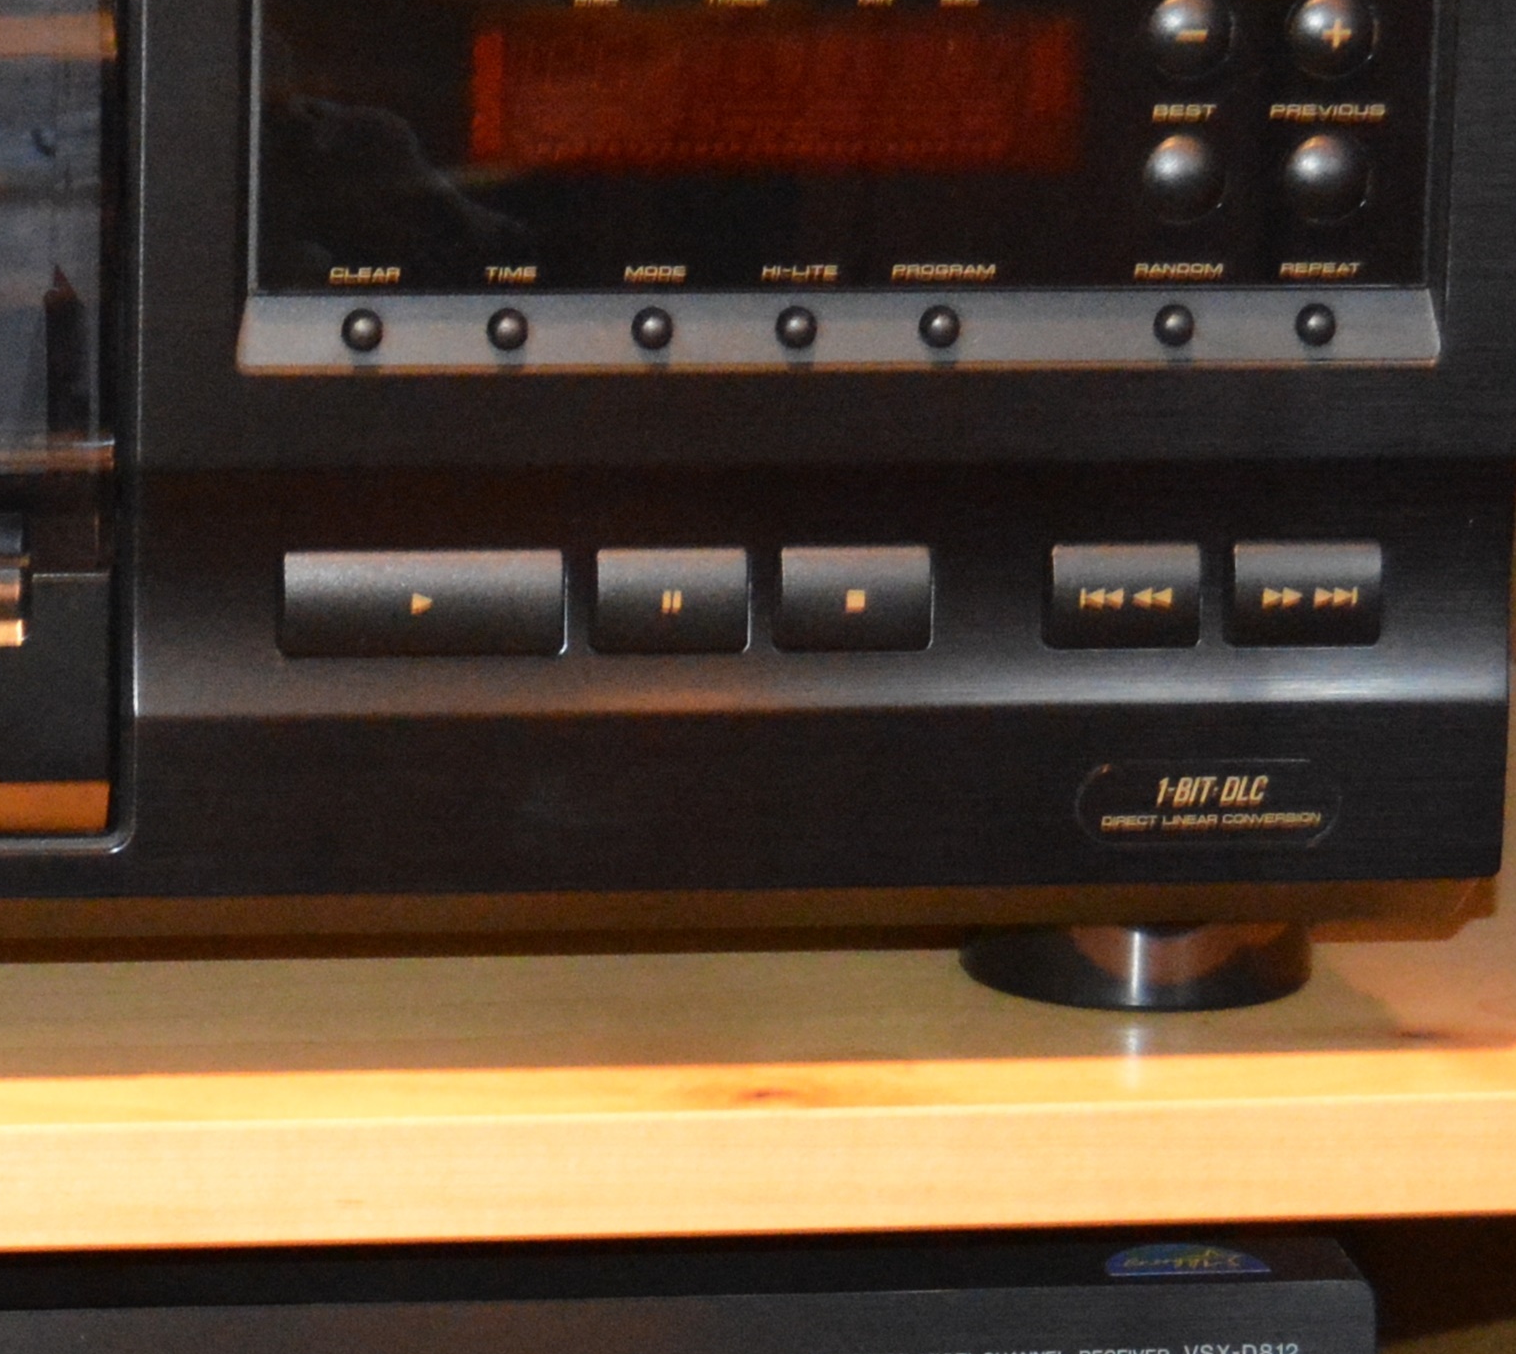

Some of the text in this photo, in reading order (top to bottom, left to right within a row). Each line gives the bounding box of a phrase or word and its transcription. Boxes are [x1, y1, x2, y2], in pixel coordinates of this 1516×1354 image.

[1152, 102, 1386, 121] BEST PREVIOUS
[329, 266, 401, 283] CLEAR
[485, 266, 538, 282] TIME
[624, 265, 687, 282] MODE
[762, 265, 839, 281] HI-LITE
[892, 263, 996, 280] PROGRAM
[1134, 262, 1224, 280] RANDOM
[1280, 262, 1360, 279] REPEAT
[1102, 811, 1321, 831] DIRECT LINEAR CONVERSION
